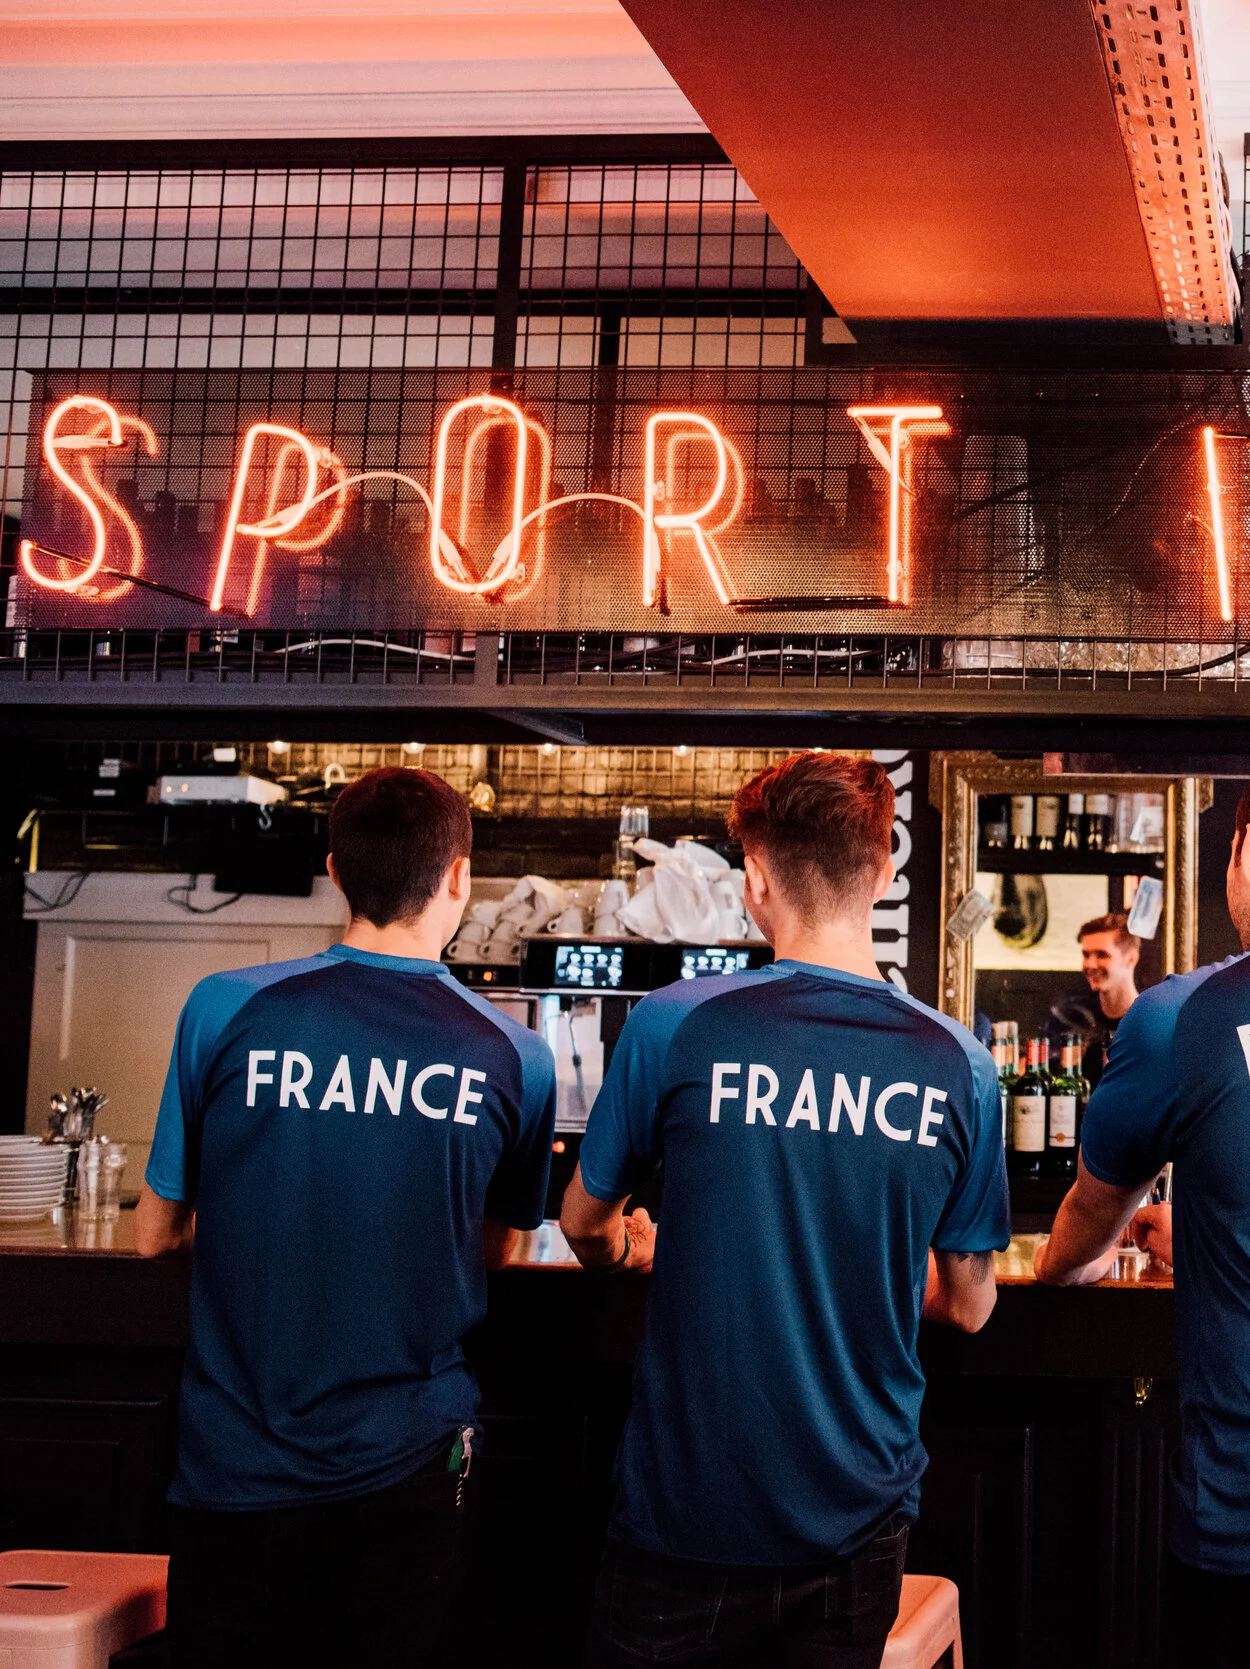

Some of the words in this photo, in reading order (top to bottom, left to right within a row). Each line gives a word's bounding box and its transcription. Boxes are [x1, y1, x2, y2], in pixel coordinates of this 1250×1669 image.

[20, 393, 946, 614] SPORT
[246, 1049, 487, 1125] FRANCE
[709, 1062, 948, 1147] FRANCE
